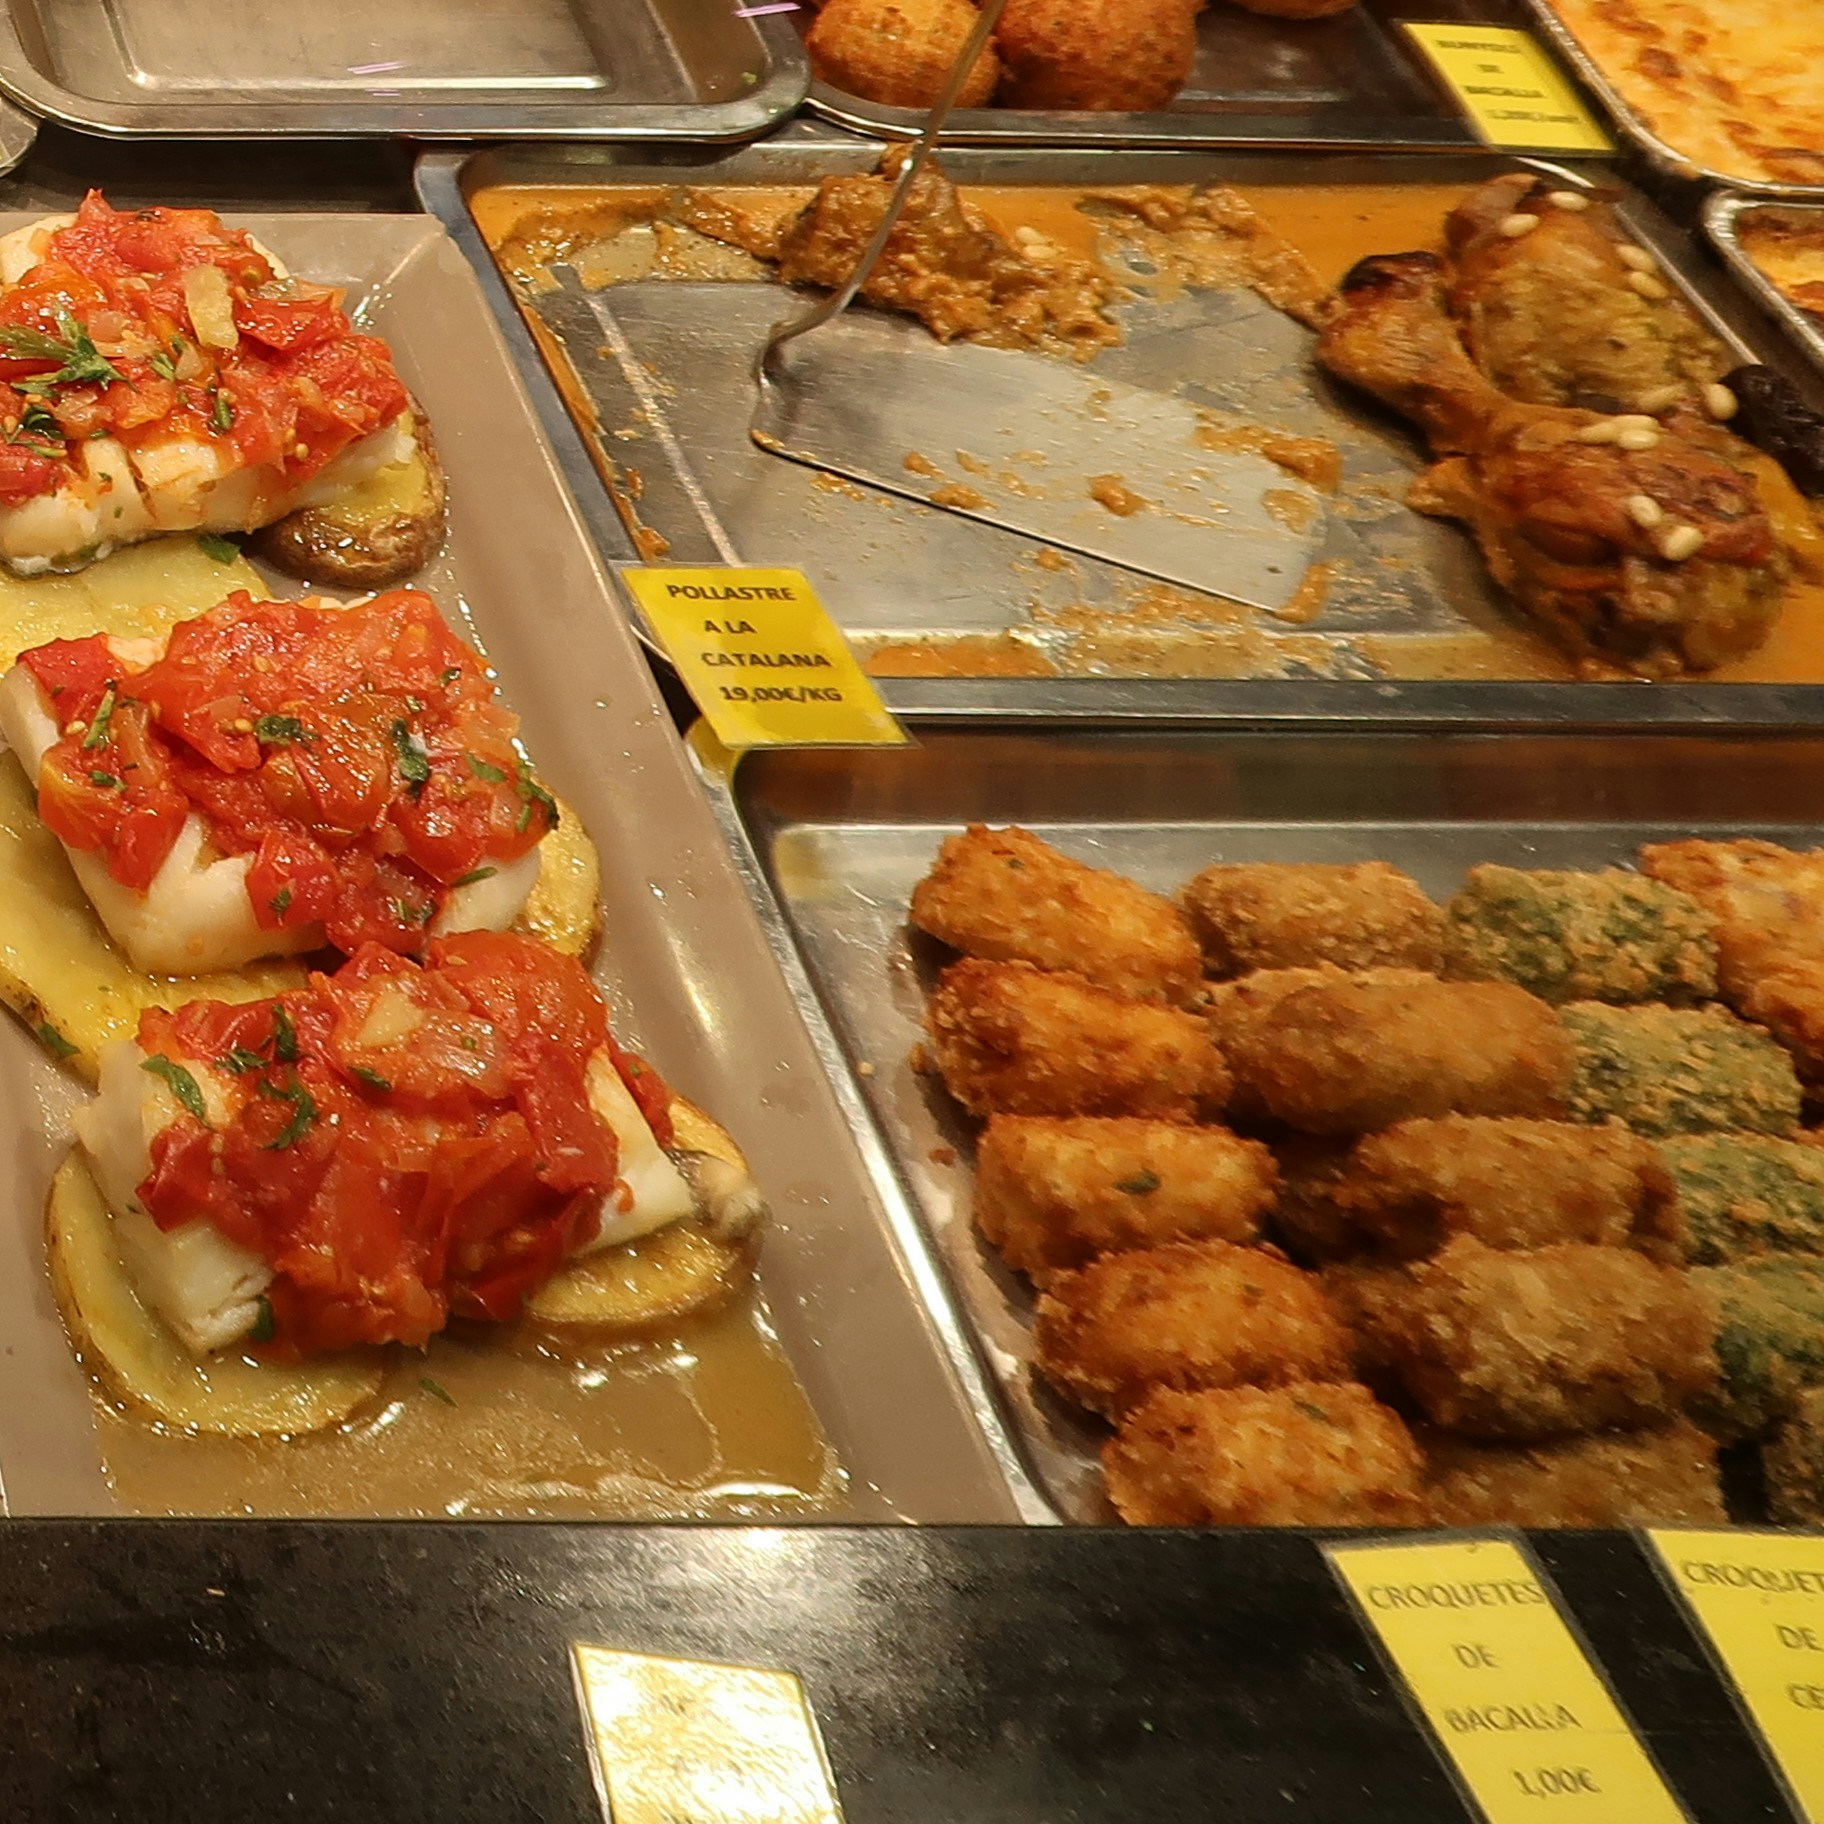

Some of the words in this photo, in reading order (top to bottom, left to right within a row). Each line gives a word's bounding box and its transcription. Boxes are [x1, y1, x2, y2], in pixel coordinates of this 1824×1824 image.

[666, 584, 798, 602] POLLASTRE
[704, 620, 721, 634] A
[725, 620, 756, 635] LA
[701, 652, 832, 669] CATALANA
[719, 686, 843, 704] 19,00€/KG
[1367, 1577, 1548, 1610] CROQUETES
[1774, 1623, 1824, 1652] DE
[1450, 1642, 1501, 1670] DE
[1512, 1767, 1603, 1800] 1,00€
